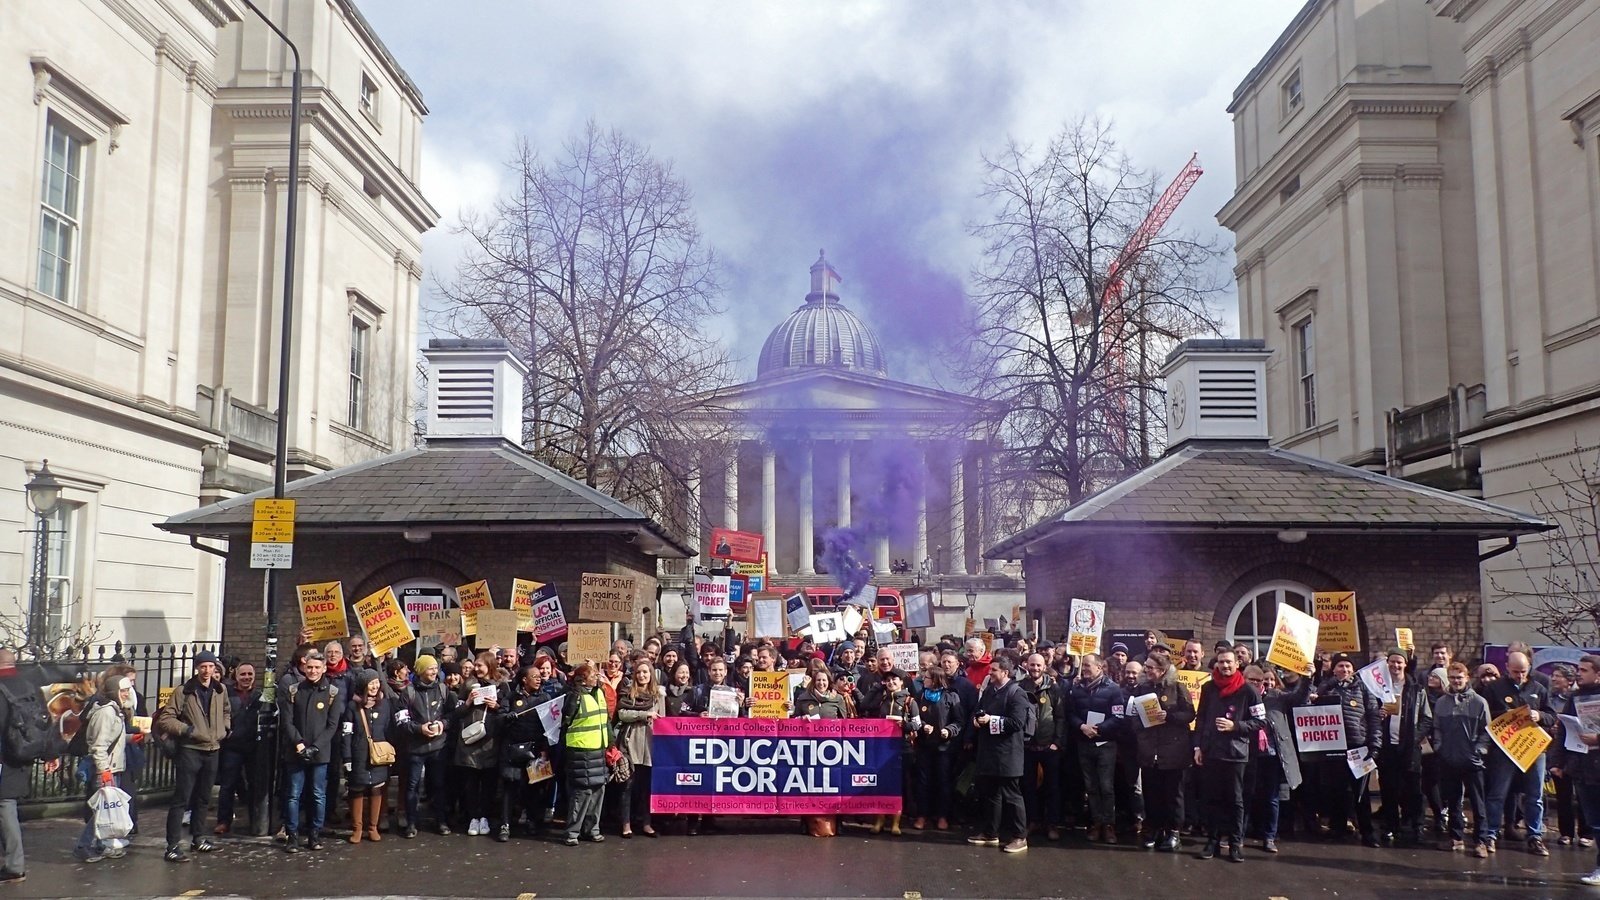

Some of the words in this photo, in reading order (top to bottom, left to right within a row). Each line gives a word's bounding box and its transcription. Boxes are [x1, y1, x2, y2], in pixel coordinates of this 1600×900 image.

[582, 576, 611, 587] SUPPORT
[612, 579, 634, 589] STAFF
[696, 583, 728, 594] OFFICIAL
[515, 596, 531, 605] AXE
[592, 591, 621, 601] against
[698, 596, 725, 606] PICKET
[305, 603, 339, 613] AXED.
[358, 602, 372, 612] OUR
[463, 599, 489, 611] AXED.
[534, 600, 559, 618] UCU
[612, 601, 632, 612] CUTS
[365, 609, 396, 628] AXED.
[429, 610, 451, 620] FAIR
[535, 612, 561, 625] OFFICIAL
[1318, 613, 1351, 622] AXED.
[572, 627, 589, 635] Who
[1278, 636, 1297, 647] Support
[1274, 648, 1292, 658] defend
[1285, 646, 1299, 654] strike
[754, 691, 784, 700] AXED.
[1297, 715, 1341, 727] OFFICIAL
[1492, 719, 1504, 730] OUR
[676, 723, 720, 732] University
[743, 723, 775, 732] College
[814, 724, 846, 732] London
[849, 724, 879, 733] Region
[1302, 730, 1339, 742] PICKET
[689, 738, 865, 766] EDUCATION
[677, 774, 700, 782] UCU
[716, 766, 777, 792] FOR
[783, 767, 839, 793] ALL
[658, 800, 691, 810] Support
[712, 801, 743, 810] pension
[764, 803, 779, 811] pay
[781, 801, 809, 810] strikes
[819, 801, 840, 810] Scrap
[841, 801, 876, 809] student
[878, 801, 895, 809] fees
